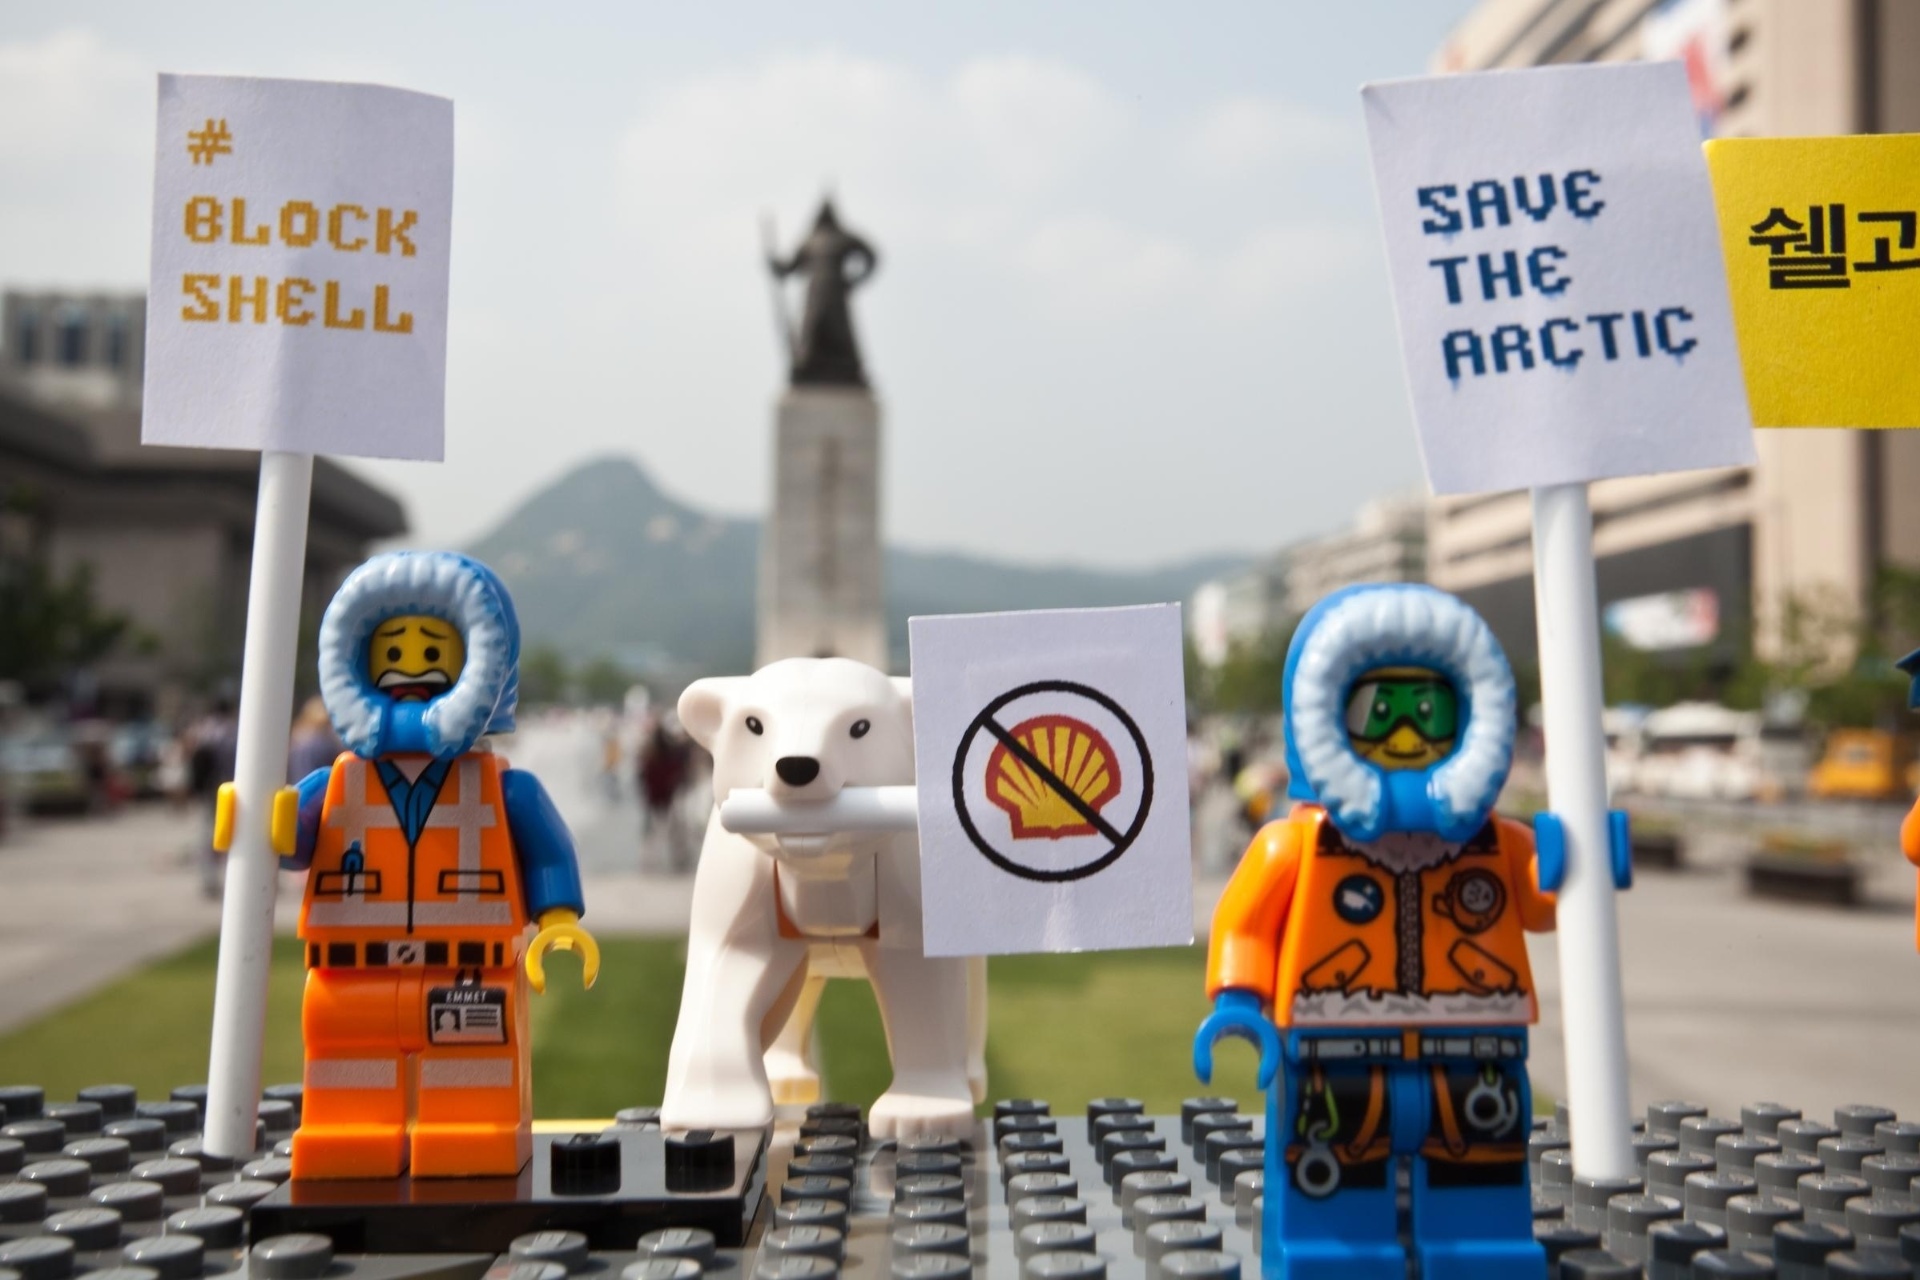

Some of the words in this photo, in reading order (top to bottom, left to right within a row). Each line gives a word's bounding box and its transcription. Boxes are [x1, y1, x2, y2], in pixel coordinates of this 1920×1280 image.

[182, 196, 418, 257] BLOCK
[1417, 169, 1605, 237] SAVE
[181, 273, 414, 334] SHELL
[1429, 245, 1571, 304] THE
[1442, 306, 1697, 383] ARCTIC
[445, 990, 488, 1004] EMMET
